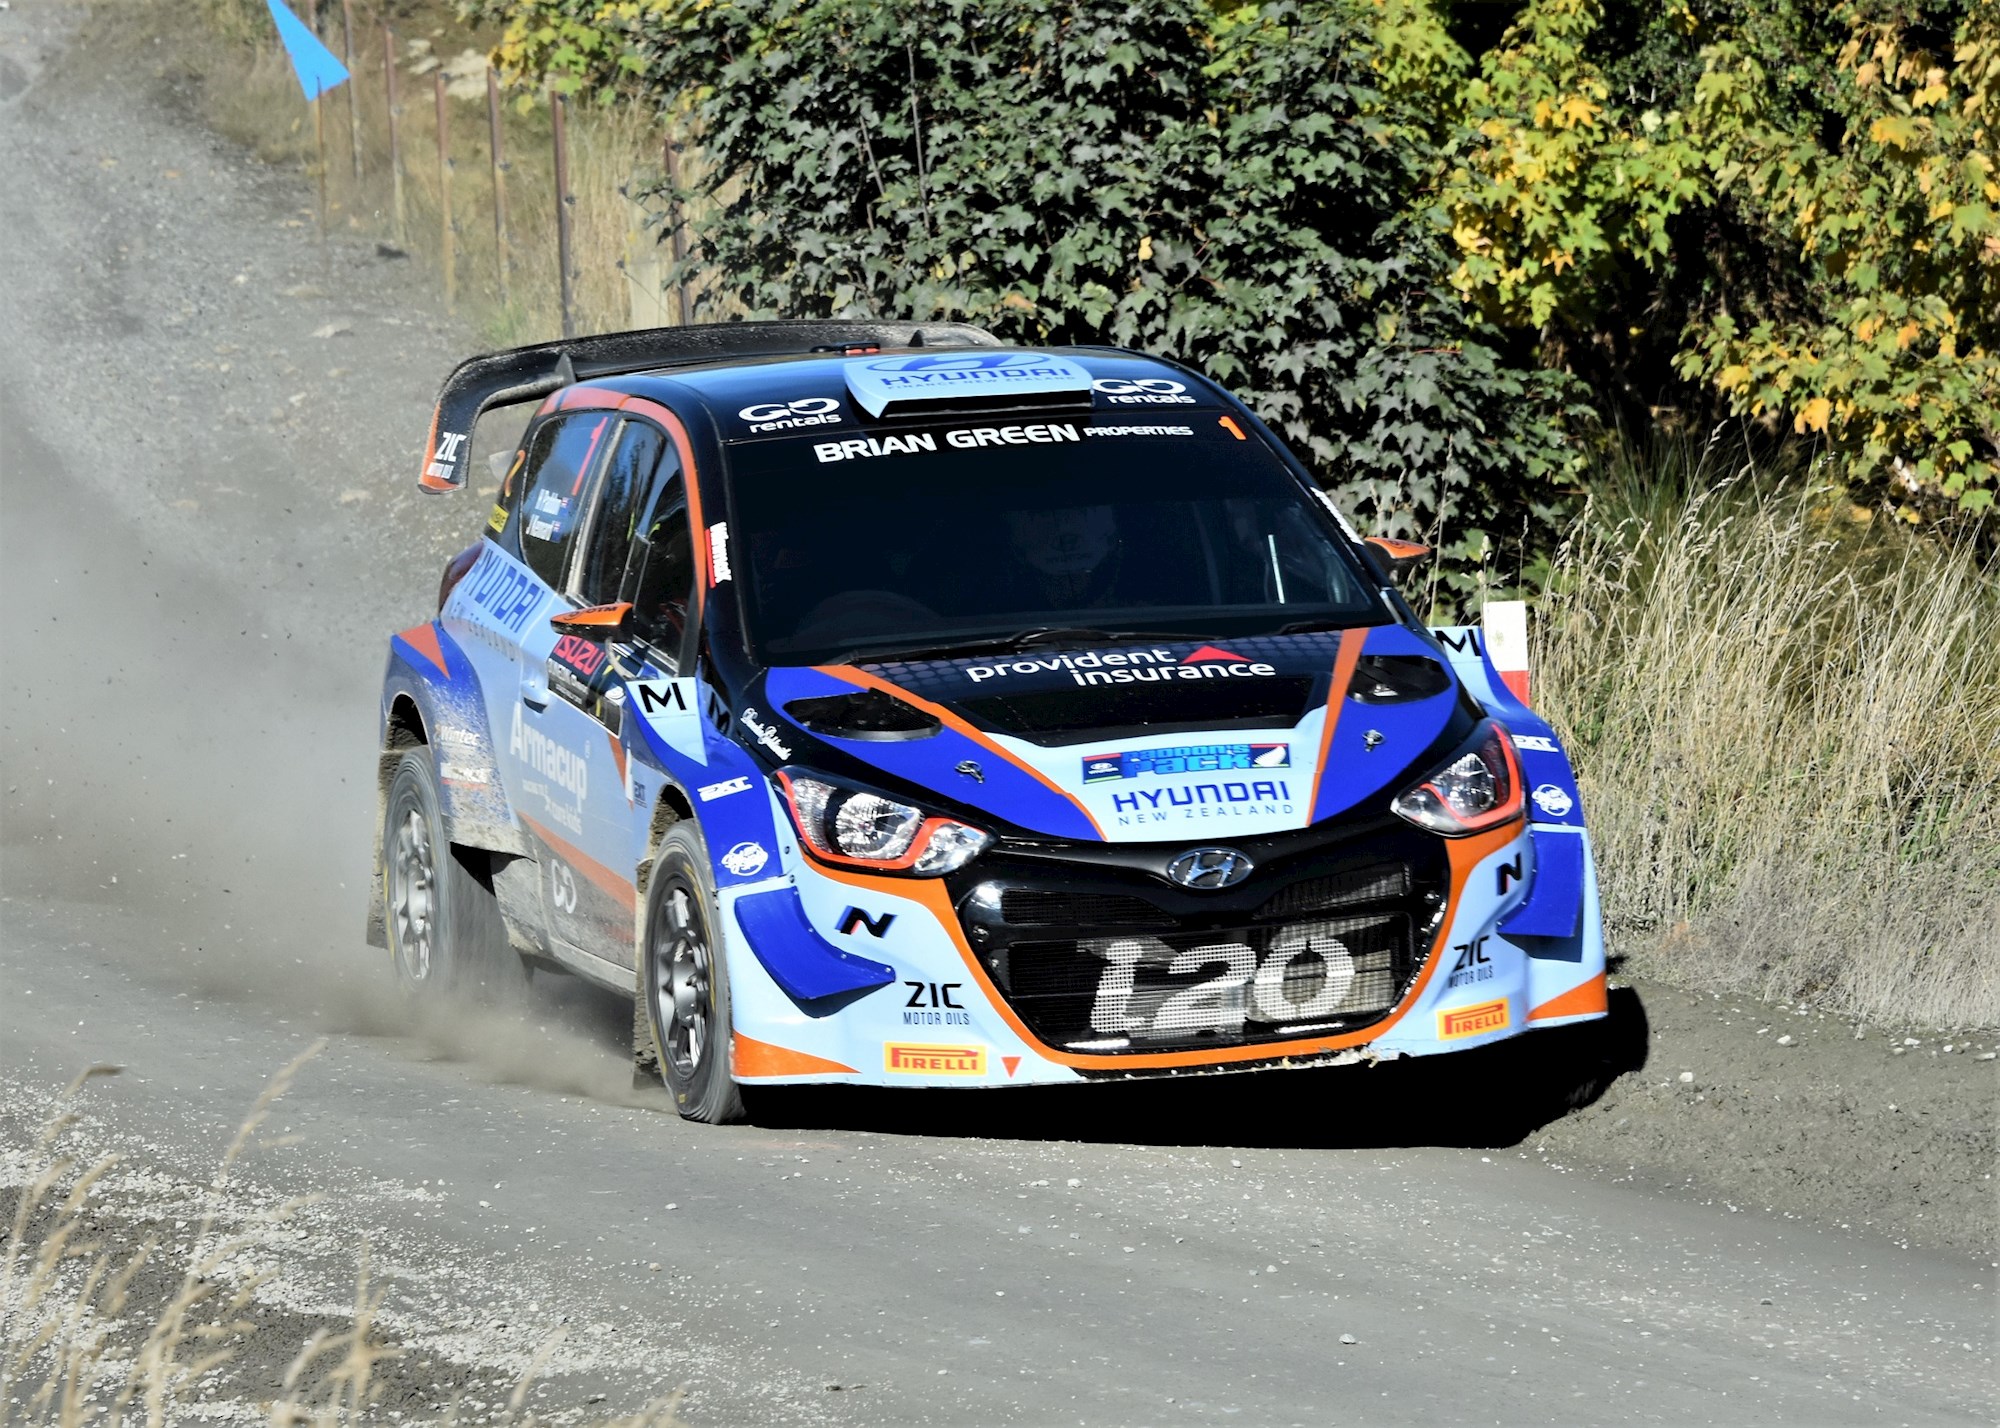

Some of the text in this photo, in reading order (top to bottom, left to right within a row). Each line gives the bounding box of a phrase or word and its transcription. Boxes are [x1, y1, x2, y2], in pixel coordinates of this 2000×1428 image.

[881, 368, 1071, 386] HYUNDAI
[1092, 379, 1187, 394] GO
[738, 397, 840, 422] GO
[1107, 394, 1197, 404] rentals
[749, 413, 842, 434] rentals
[1218, 415, 1247, 440] 1
[433, 431, 468, 462] ZIC
[813, 424, 1195, 463] BRIAN GREEN PROPERTIES
[460, 548, 545, 634] HYUNDAI
[553, 634, 607, 676] ISUZU
[1435, 629, 1482, 657] M
[965, 649, 1178, 683] provident
[1070, 661, 1277, 687] insurance
[638, 682, 688, 713] M
[509, 700, 588, 814] Armacup
[1112, 780, 1291, 813] HYUNDAI
[1118, 803, 1294, 827] NEW ZEALAND
[834, 904, 898, 939] N
[1452, 935, 1491, 972] ZIC
[1448, 964, 1494, 989] MOTOR OILS
[903, 980, 963, 1010] ZIC
[903, 1011, 971, 1025] MOTOR OILS
[1444, 1002, 1505, 1035] PIRELLI
[891, 1046, 979, 1070] PIRELLI
